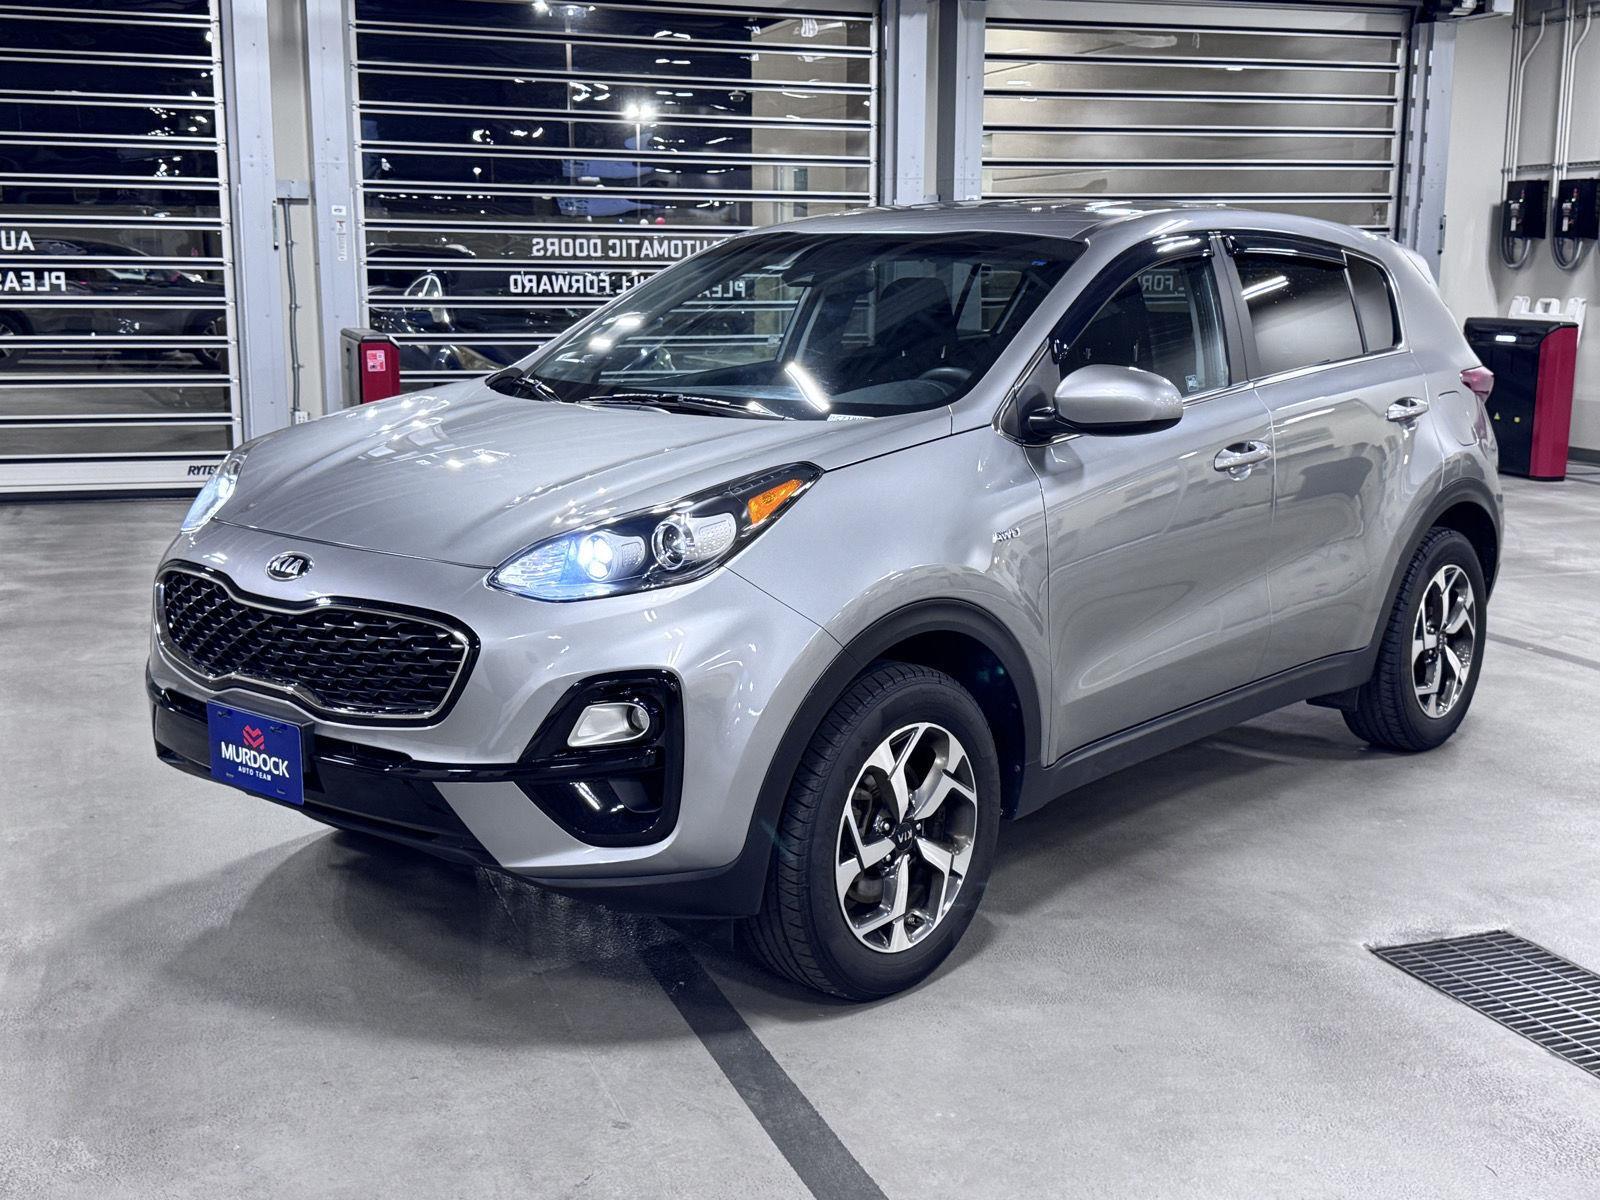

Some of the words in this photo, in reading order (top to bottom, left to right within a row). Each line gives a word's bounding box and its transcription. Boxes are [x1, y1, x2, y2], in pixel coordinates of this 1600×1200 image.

[187, 465, 220, 476] RYTE
[270, 556, 304, 575] KIA
[221, 741, 290, 778] MURDOCK
[238, 765, 254, 776] AUTO
[255, 770, 272, 781] TEAM
[897, 829, 913, 843] KIA
